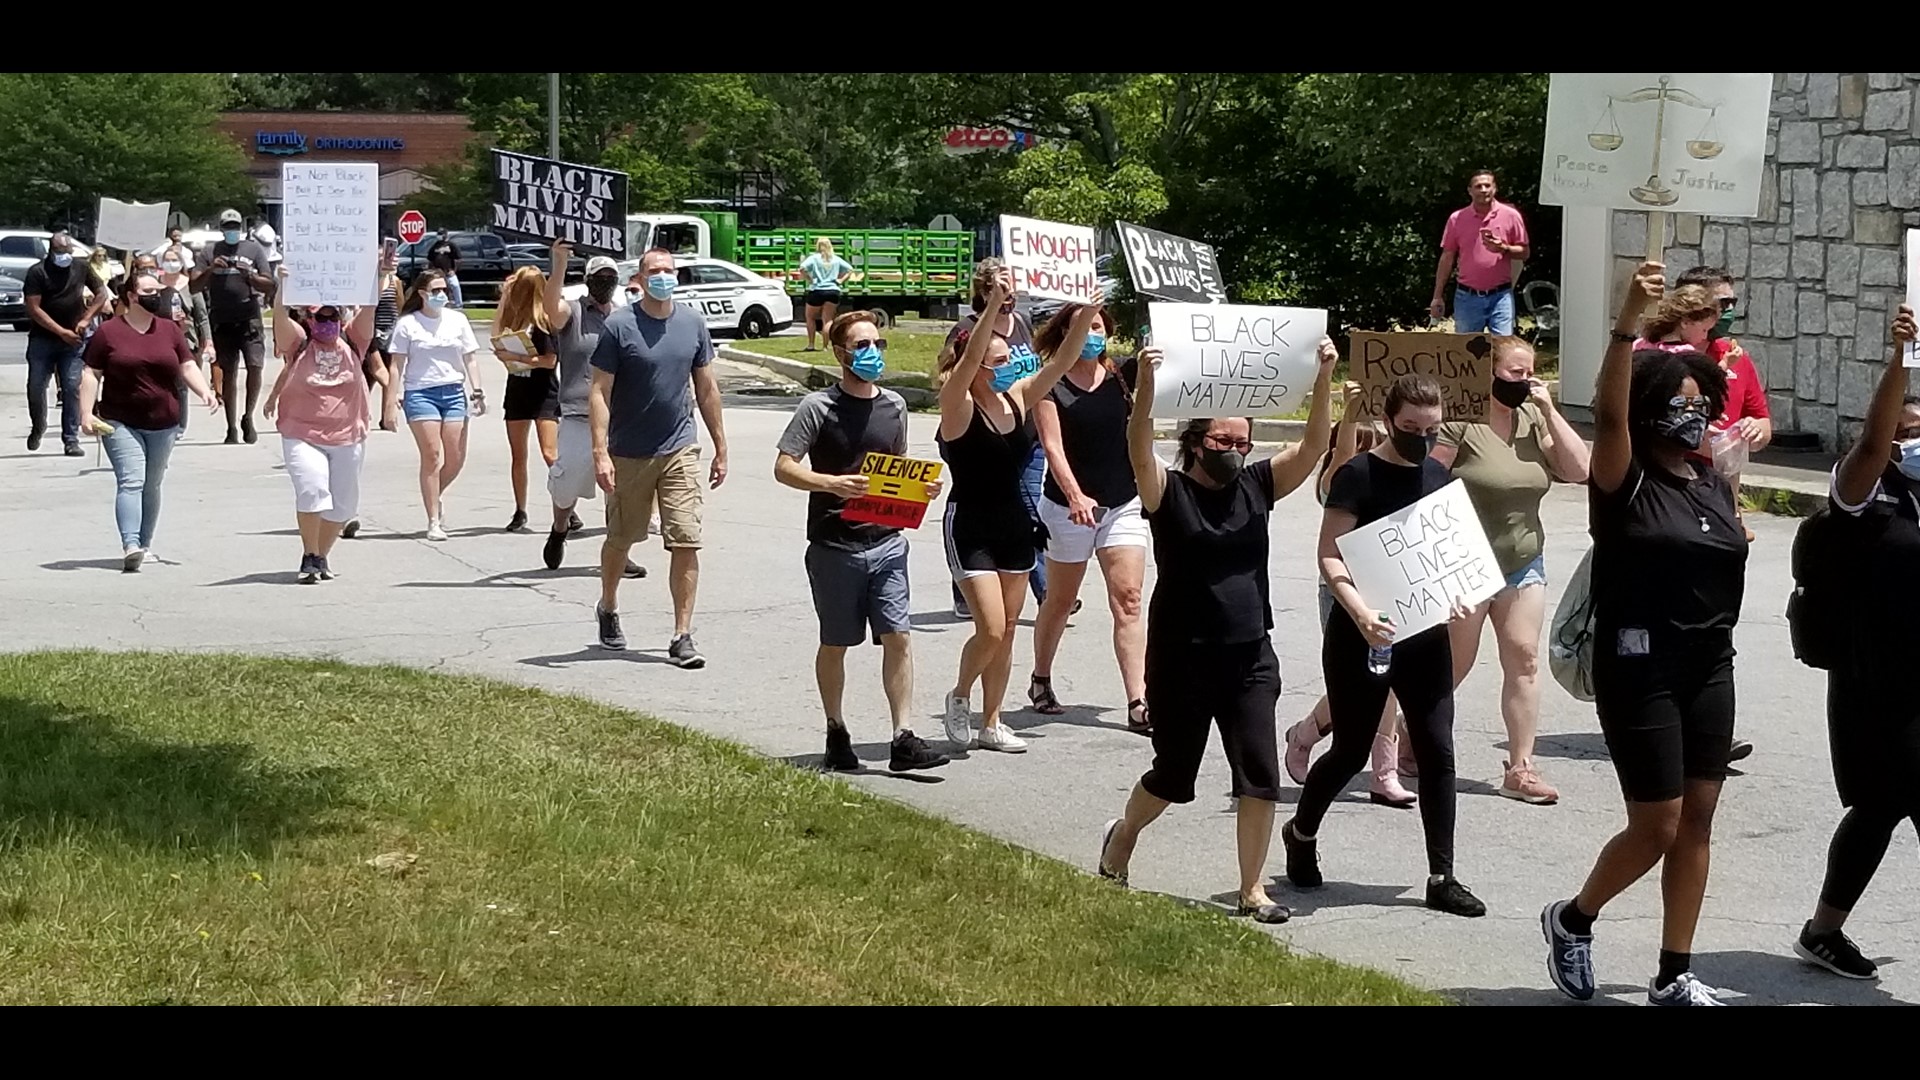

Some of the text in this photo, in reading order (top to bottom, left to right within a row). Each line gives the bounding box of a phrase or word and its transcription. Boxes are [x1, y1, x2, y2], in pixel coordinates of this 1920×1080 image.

[256, 129, 405, 150] family ORTHODONTICS
[309, 168, 328, 180] Not
[500, 155, 614, 201] BLACK
[1556, 154, 1608, 174] Peace
[316, 185, 323, 195] I
[327, 185, 345, 195] See
[1671, 168, 1737, 193] Justice
[308, 202, 328, 215] Not
[508, 181, 604, 222] LIVES
[316, 223, 322, 233] I
[352, 223, 368, 233] You
[401, 220, 424, 234] STOP
[493, 203, 624, 251] MATTER
[308, 241, 329, 252] Not
[1010, 227, 1094, 264] ENOUGH
[1126, 227, 1189, 290] BLACK
[321, 260, 327, 271] I
[1158, 264, 1201, 293] LIVES
[295, 277, 357, 289] Stand With
[1190, 313, 1291, 348] BLACK
[1200, 348, 1280, 381] LIVES
[1176, 380, 1288, 409] MATTER
[862, 454, 935, 483] SILENCE
[1378, 499, 1461, 558] BLACK
[1399, 531, 1470, 586] LIVES
[1394, 557, 1491, 626] MATTER
